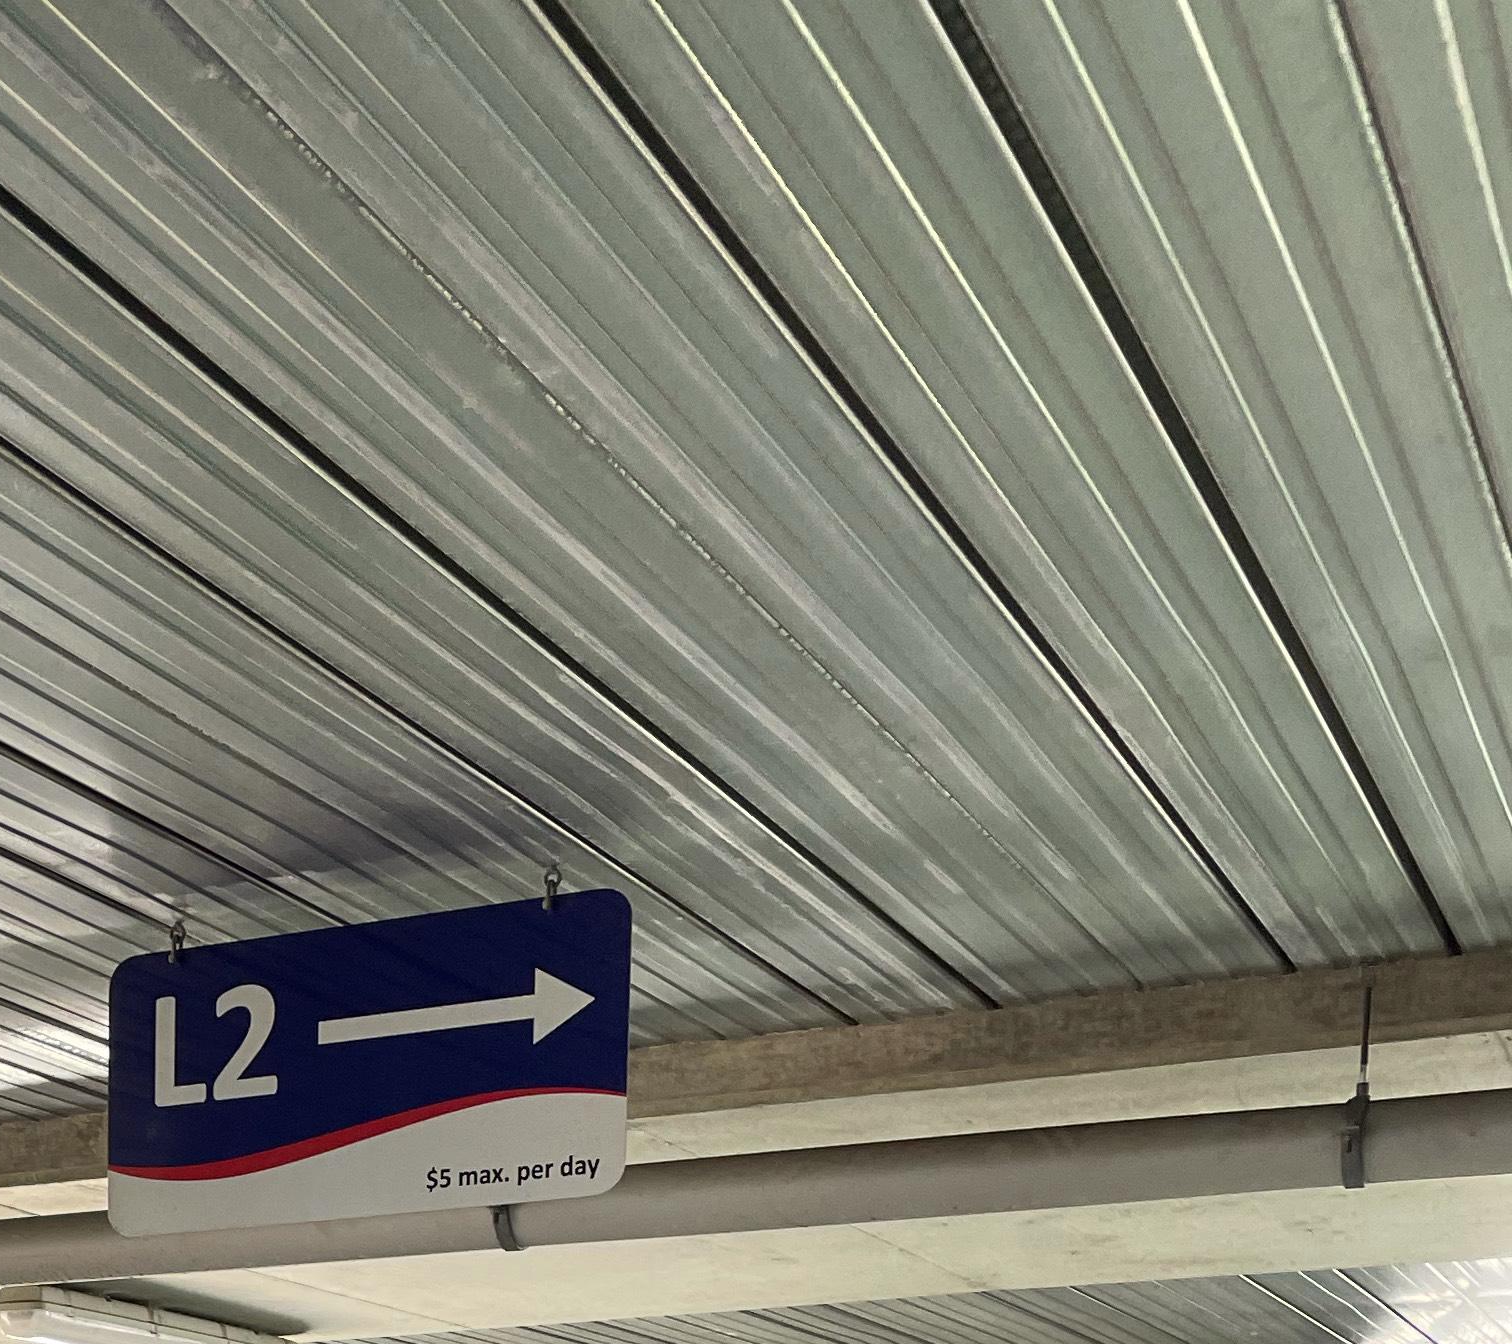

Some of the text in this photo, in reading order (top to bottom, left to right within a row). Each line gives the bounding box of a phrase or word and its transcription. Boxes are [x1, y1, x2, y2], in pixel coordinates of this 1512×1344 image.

[154, 983, 278, 1108] L2
[426, 1155, 600, 1192] $5 max. per day
